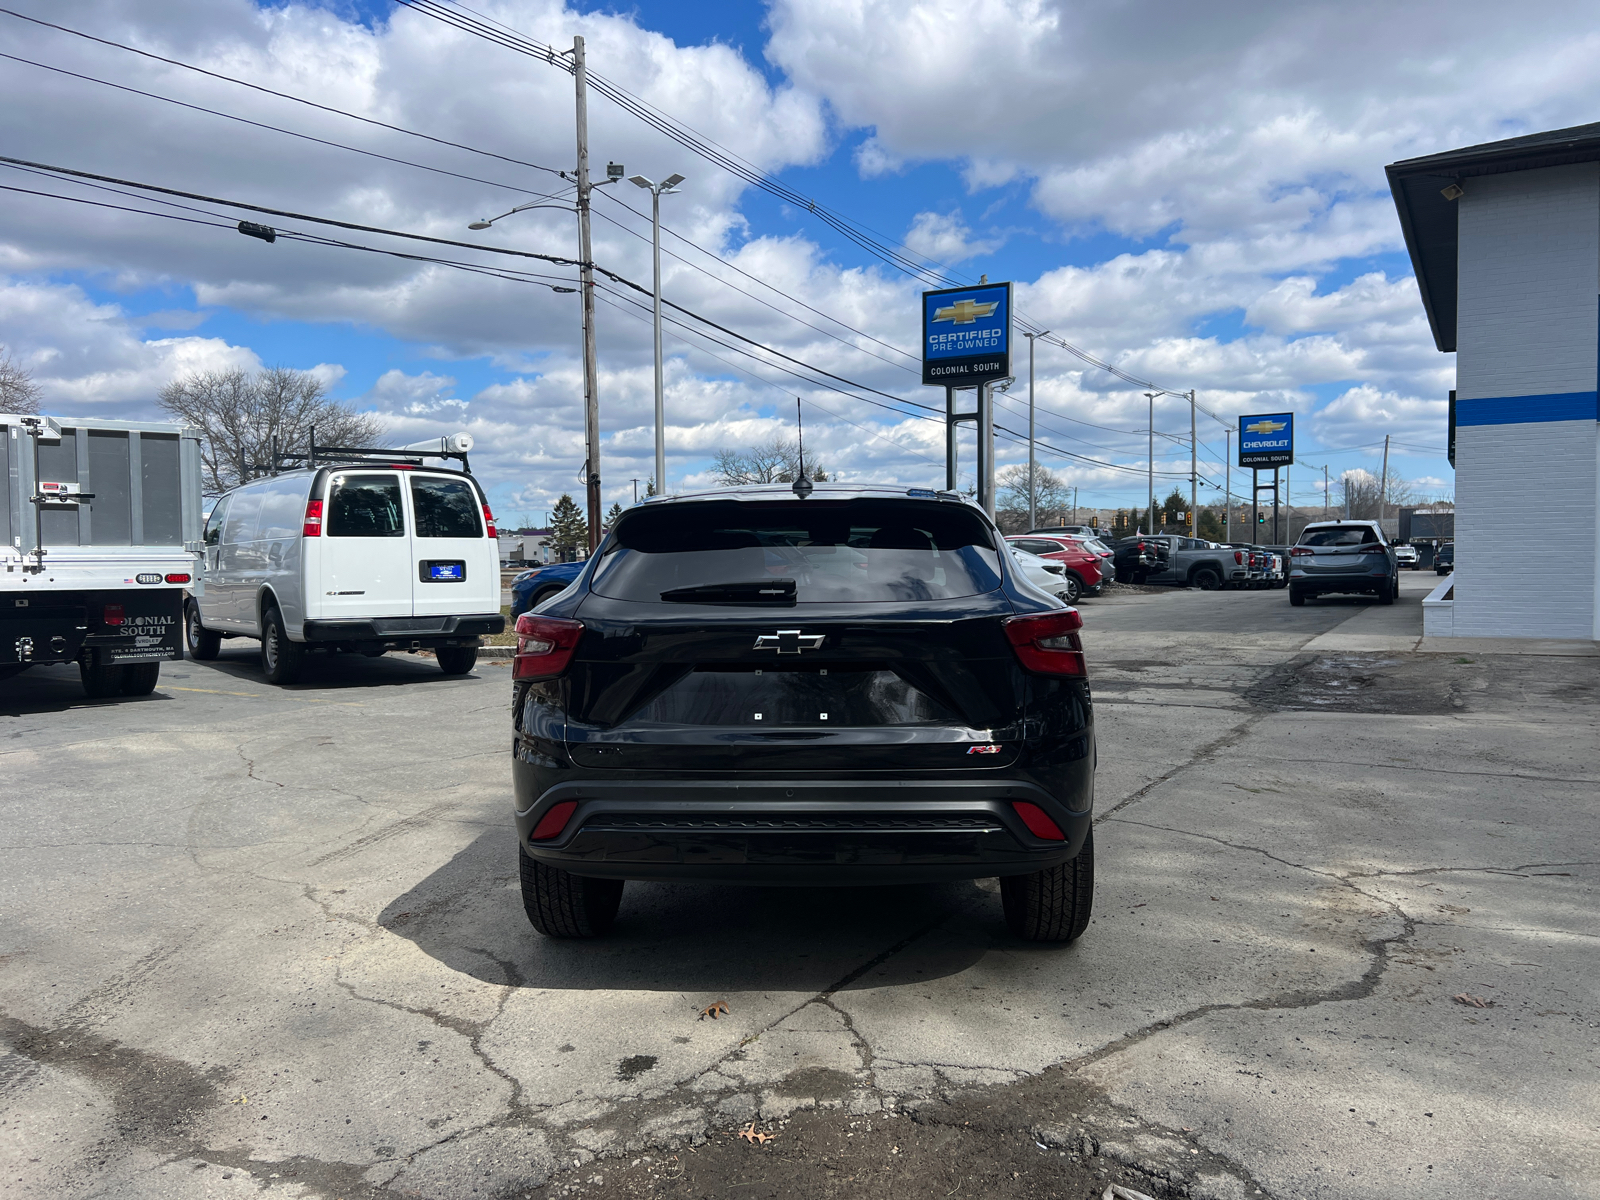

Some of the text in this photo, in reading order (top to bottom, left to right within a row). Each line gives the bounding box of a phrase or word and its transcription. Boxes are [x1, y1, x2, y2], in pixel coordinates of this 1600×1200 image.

[929, 328, 1002, 343] CERTIFIED
[932, 338, 998, 351] PRE-OWNED
[931, 362, 1000, 375] COLONIAL SOUTH
[1243, 439, 1289, 449] CHEVROLET
[113, 615, 175, 626] OLONIAL
[120, 625, 166, 636] SOUTH
